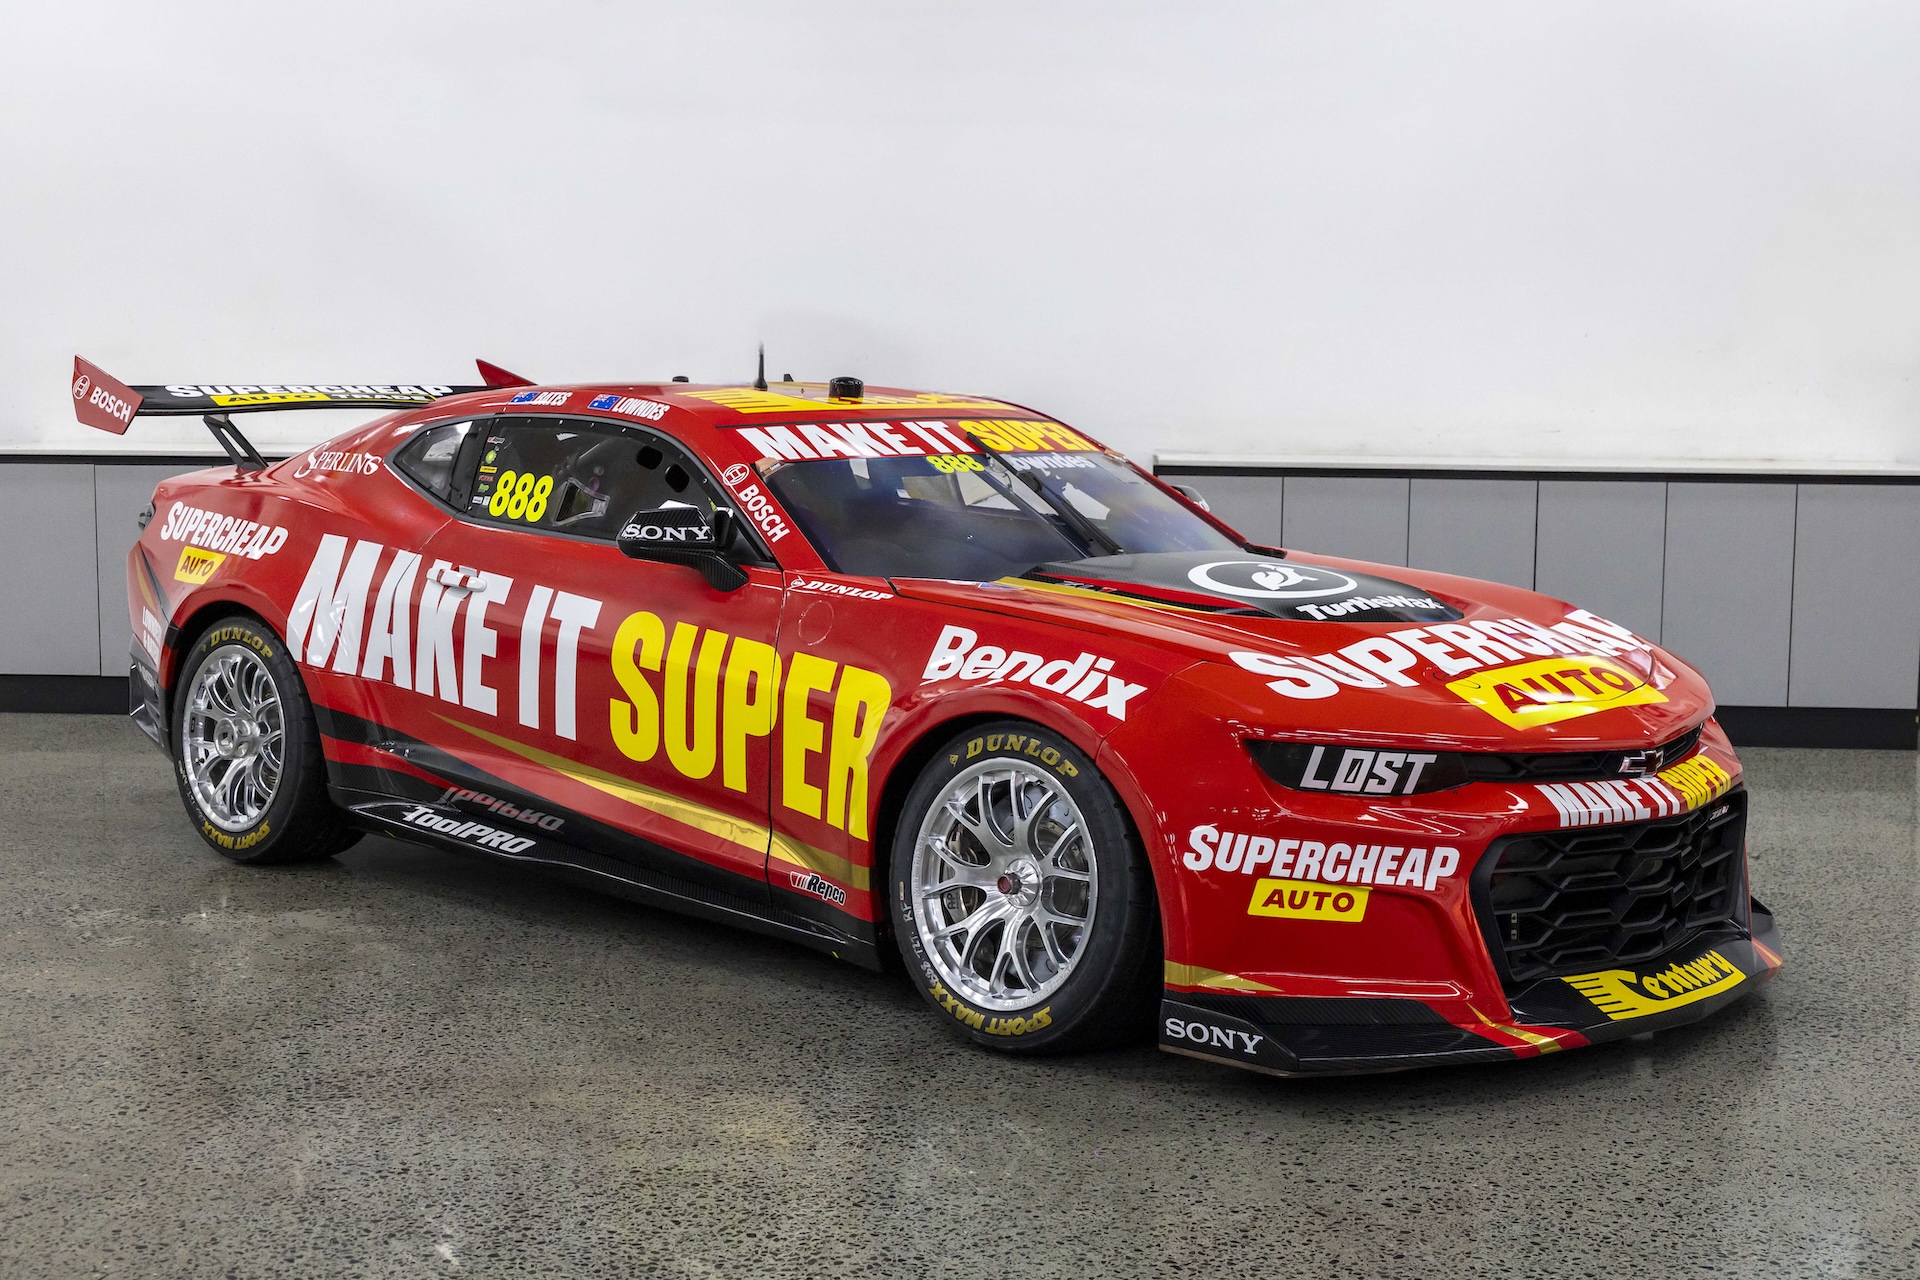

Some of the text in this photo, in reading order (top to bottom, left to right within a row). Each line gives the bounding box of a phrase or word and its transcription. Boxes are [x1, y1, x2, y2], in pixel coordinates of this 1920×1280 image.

[89, 387, 132, 423] BOSCH
[228, 394, 318, 402] AUTO
[612, 396, 670, 421] LOWNDES
[293, 441, 382, 478] SPERLING
[736, 419, 1101, 461] MAKE IT SUPER
[926, 453, 985, 473] 888
[489, 470, 554, 522] 888
[739, 484, 790, 543] BOSCH
[160, 501, 289, 560] SUPERCHEAP
[622, 523, 710, 541] SONY
[180, 556, 215, 576] AUTO
[804, 580, 893, 600] DUNLOP
[210, 628, 273, 658] DUNLOP
[1228, 609, 1652, 700] SUPERCHAP
[286, 533, 893, 841] MAKE IT SUPER
[919, 624, 1148, 722] Bendix
[1492, 666, 1632, 714] AUTO
[966, 734, 1078, 778] DUNLOP
[1300, 745, 1437, 794] LOST
[1534, 755, 1732, 827] MAKE IT SUPER
[202, 820, 271, 850] SPORT MAXX
[402, 806, 537, 853] ToolPRO
[1183, 825, 1461, 891] SUPERCHEAP
[806, 872, 847, 906] Repco
[1261, 888, 1355, 912] AUTO
[900, 902, 914, 923] RF
[1560, 949, 1747, 1021] Century
[928, 982, 1052, 1036] SPORT MAXX
[1165, 1018, 1264, 1054] SONY
